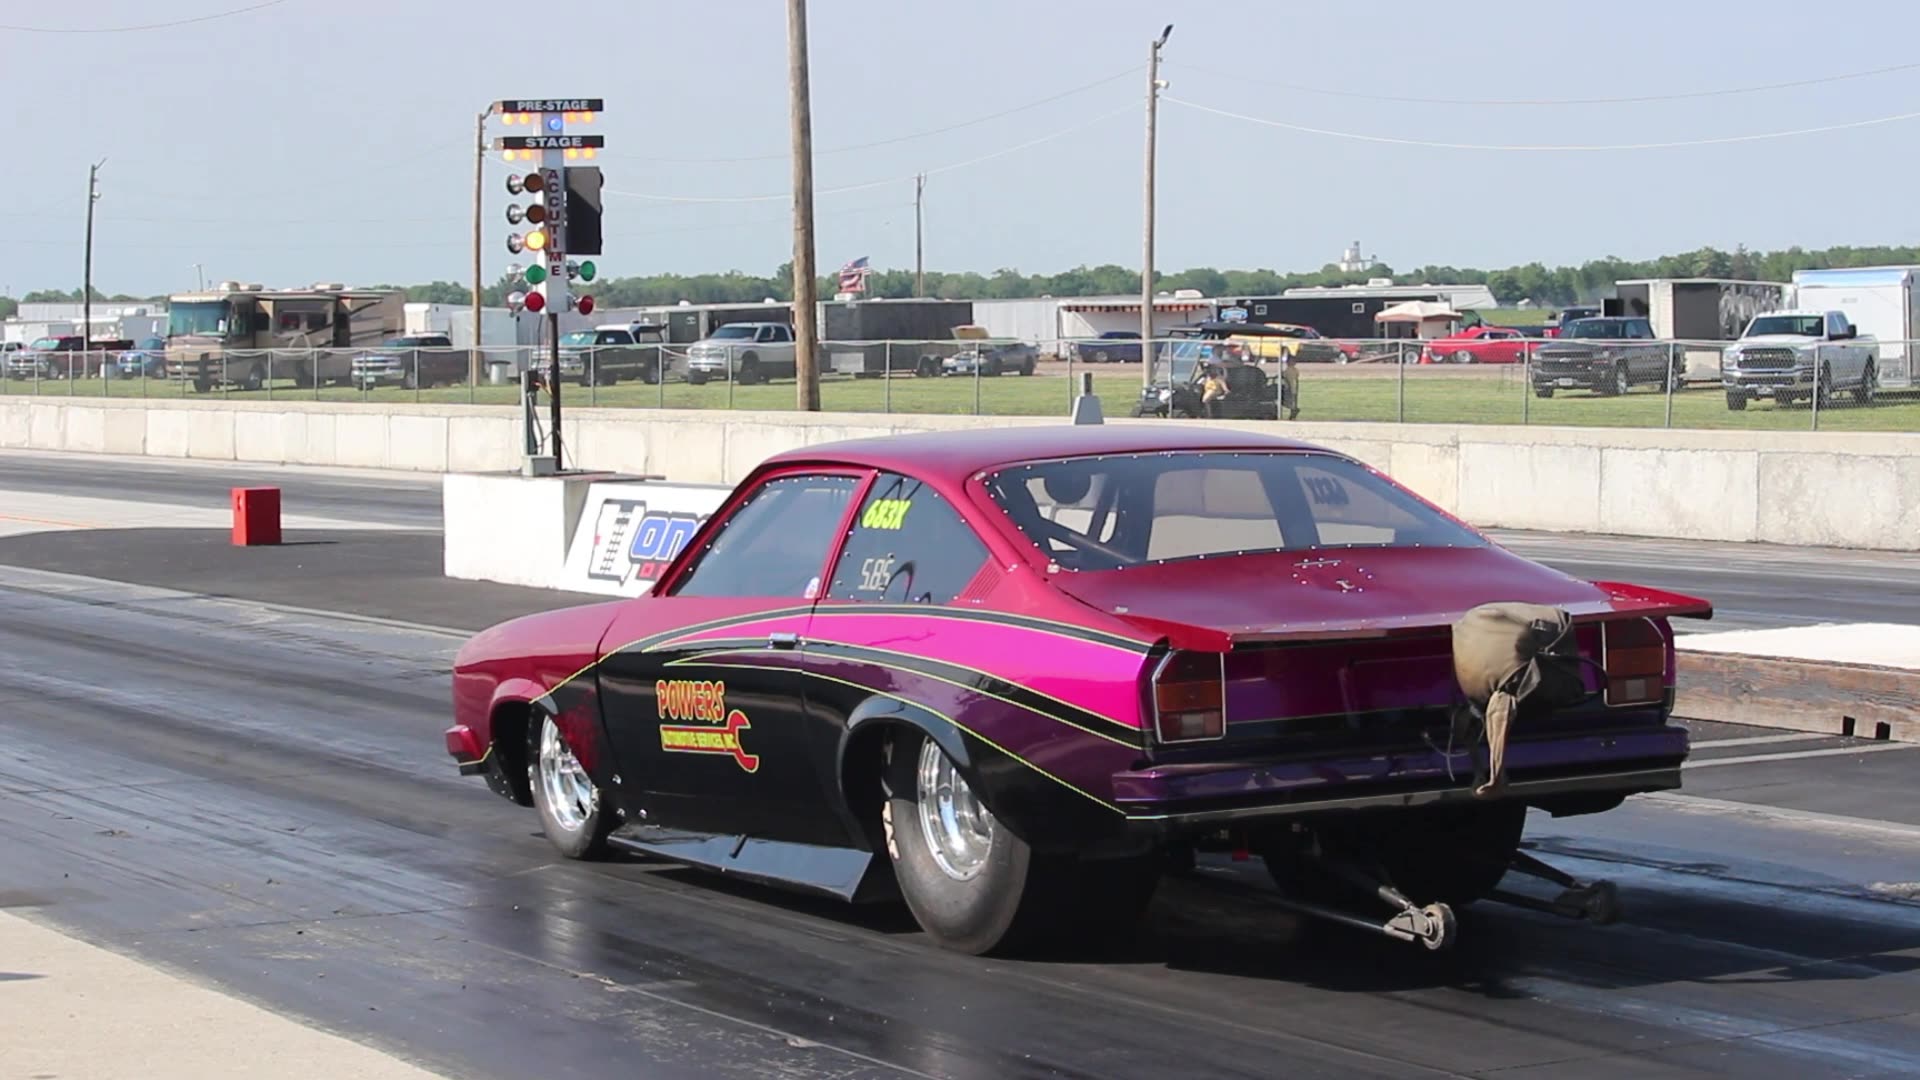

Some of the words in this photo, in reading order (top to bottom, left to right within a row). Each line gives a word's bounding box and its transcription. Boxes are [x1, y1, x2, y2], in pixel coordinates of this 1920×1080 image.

[517, 101, 590, 111] PRE-STAGE
[525, 137, 583, 148] STAGE
[548, 169, 563, 277] ACCUTIME
[656, 679, 725, 723] POWERS
